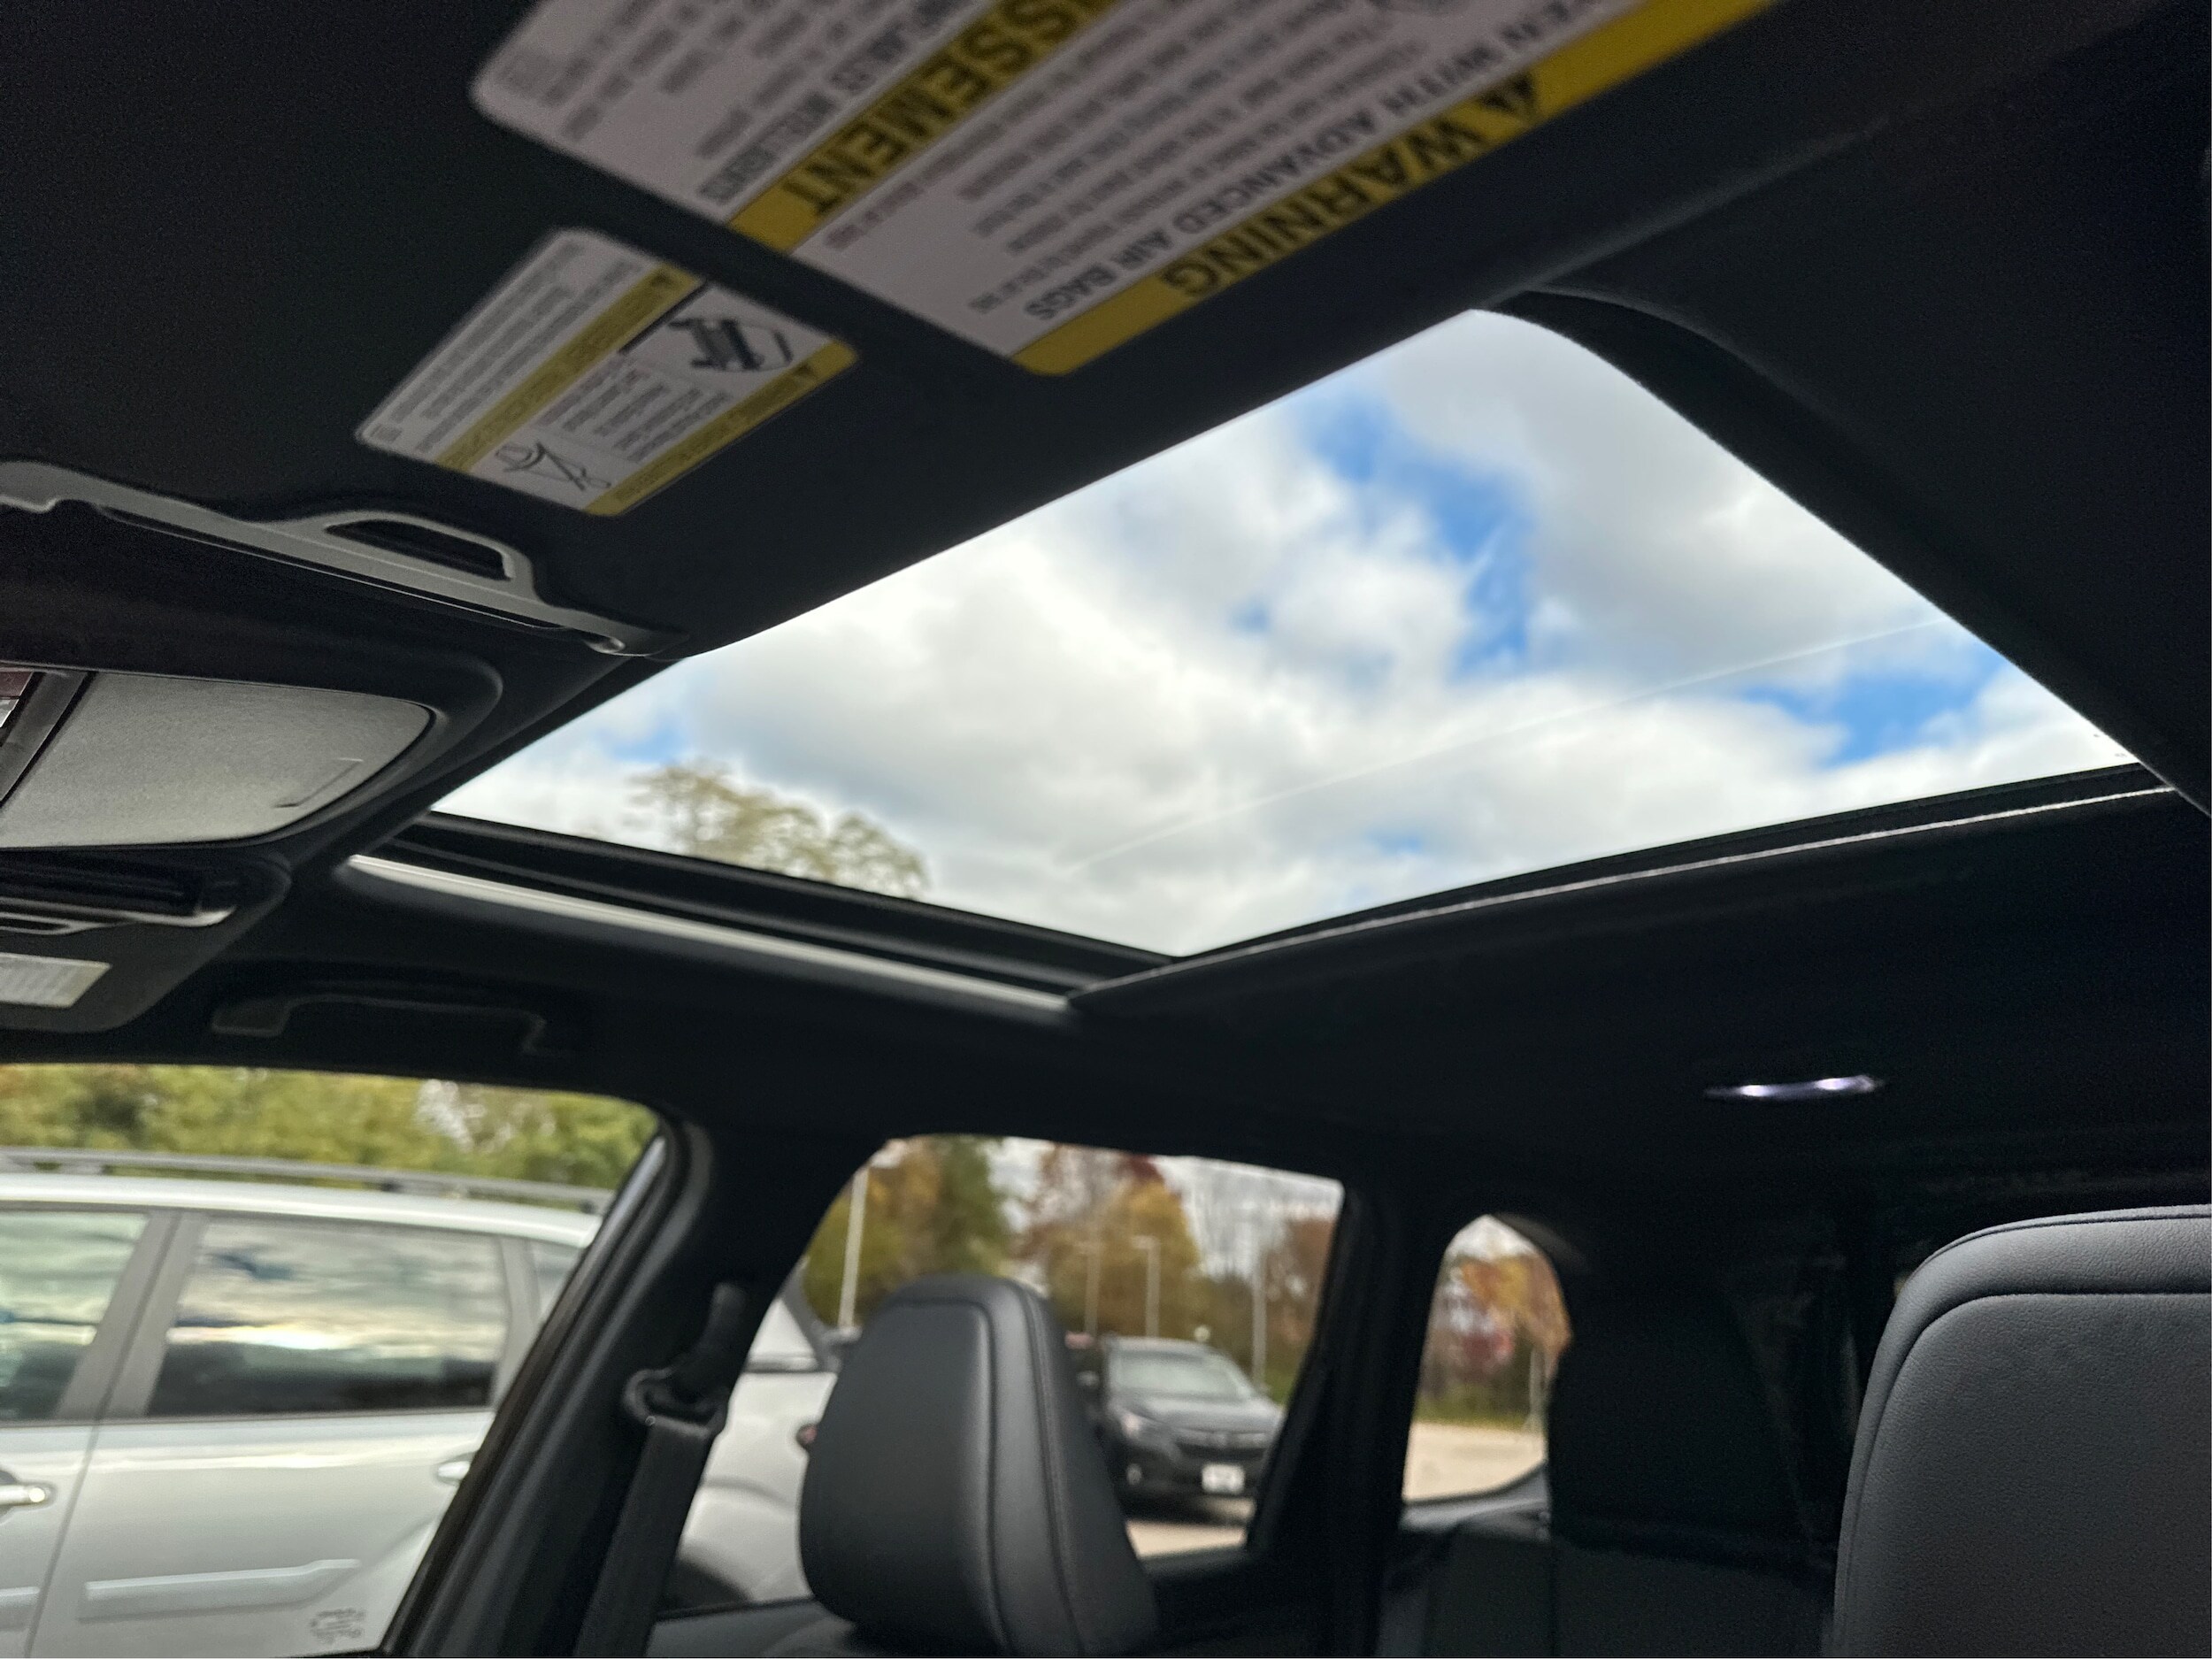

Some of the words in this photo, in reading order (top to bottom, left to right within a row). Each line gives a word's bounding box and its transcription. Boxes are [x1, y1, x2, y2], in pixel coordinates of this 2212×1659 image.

[780, 0, 1110, 219] SSEMENT
[1380, 42, 1497, 116] WITH
[1162, 116, 1492, 298] WARNING
[1172, 110, 1376, 235] ADVANCED
[1024, 265, 1118, 319] BAGS
[1111, 227, 1173, 269] AIR
